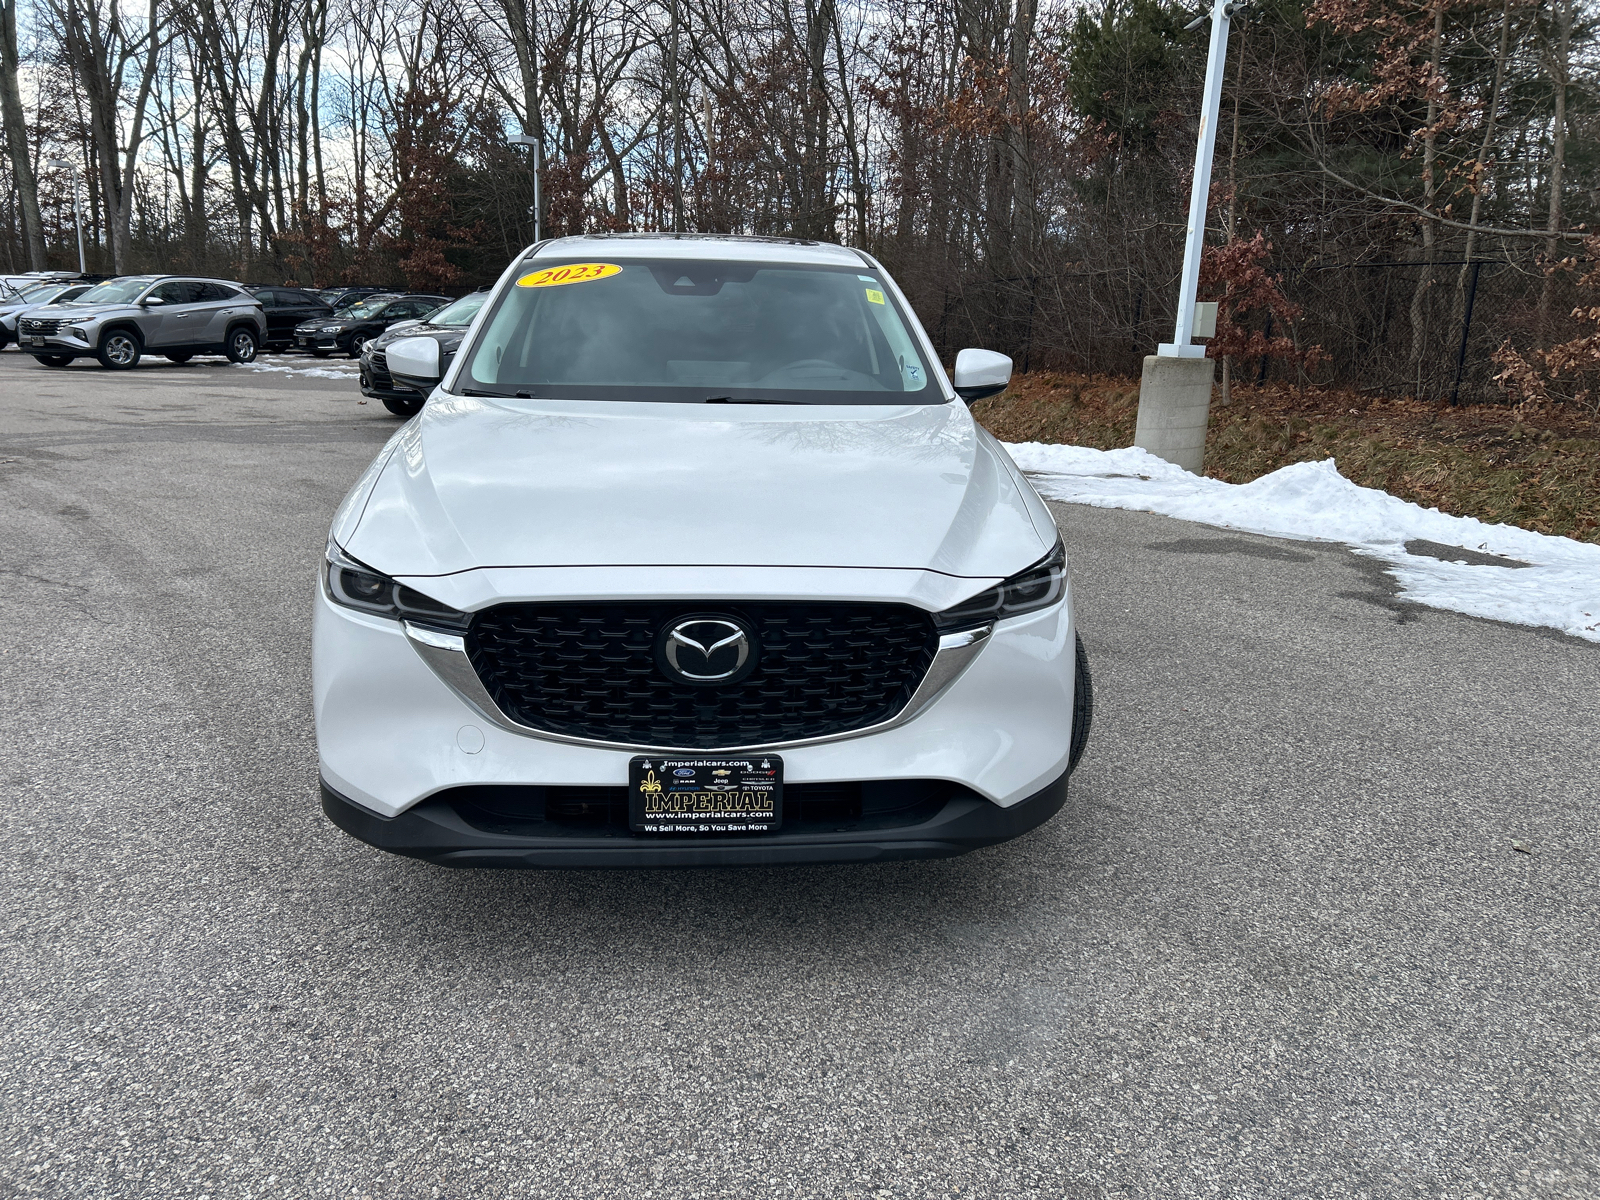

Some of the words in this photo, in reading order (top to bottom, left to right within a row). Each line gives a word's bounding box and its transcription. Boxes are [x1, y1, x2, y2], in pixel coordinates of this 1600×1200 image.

[534, 265, 605, 285] 2023
[663, 760, 749, 768] Imperialcars.com
[645, 792, 773, 812] IMPERIAL
[645, 812, 773, 820] www.imperialcars.com
